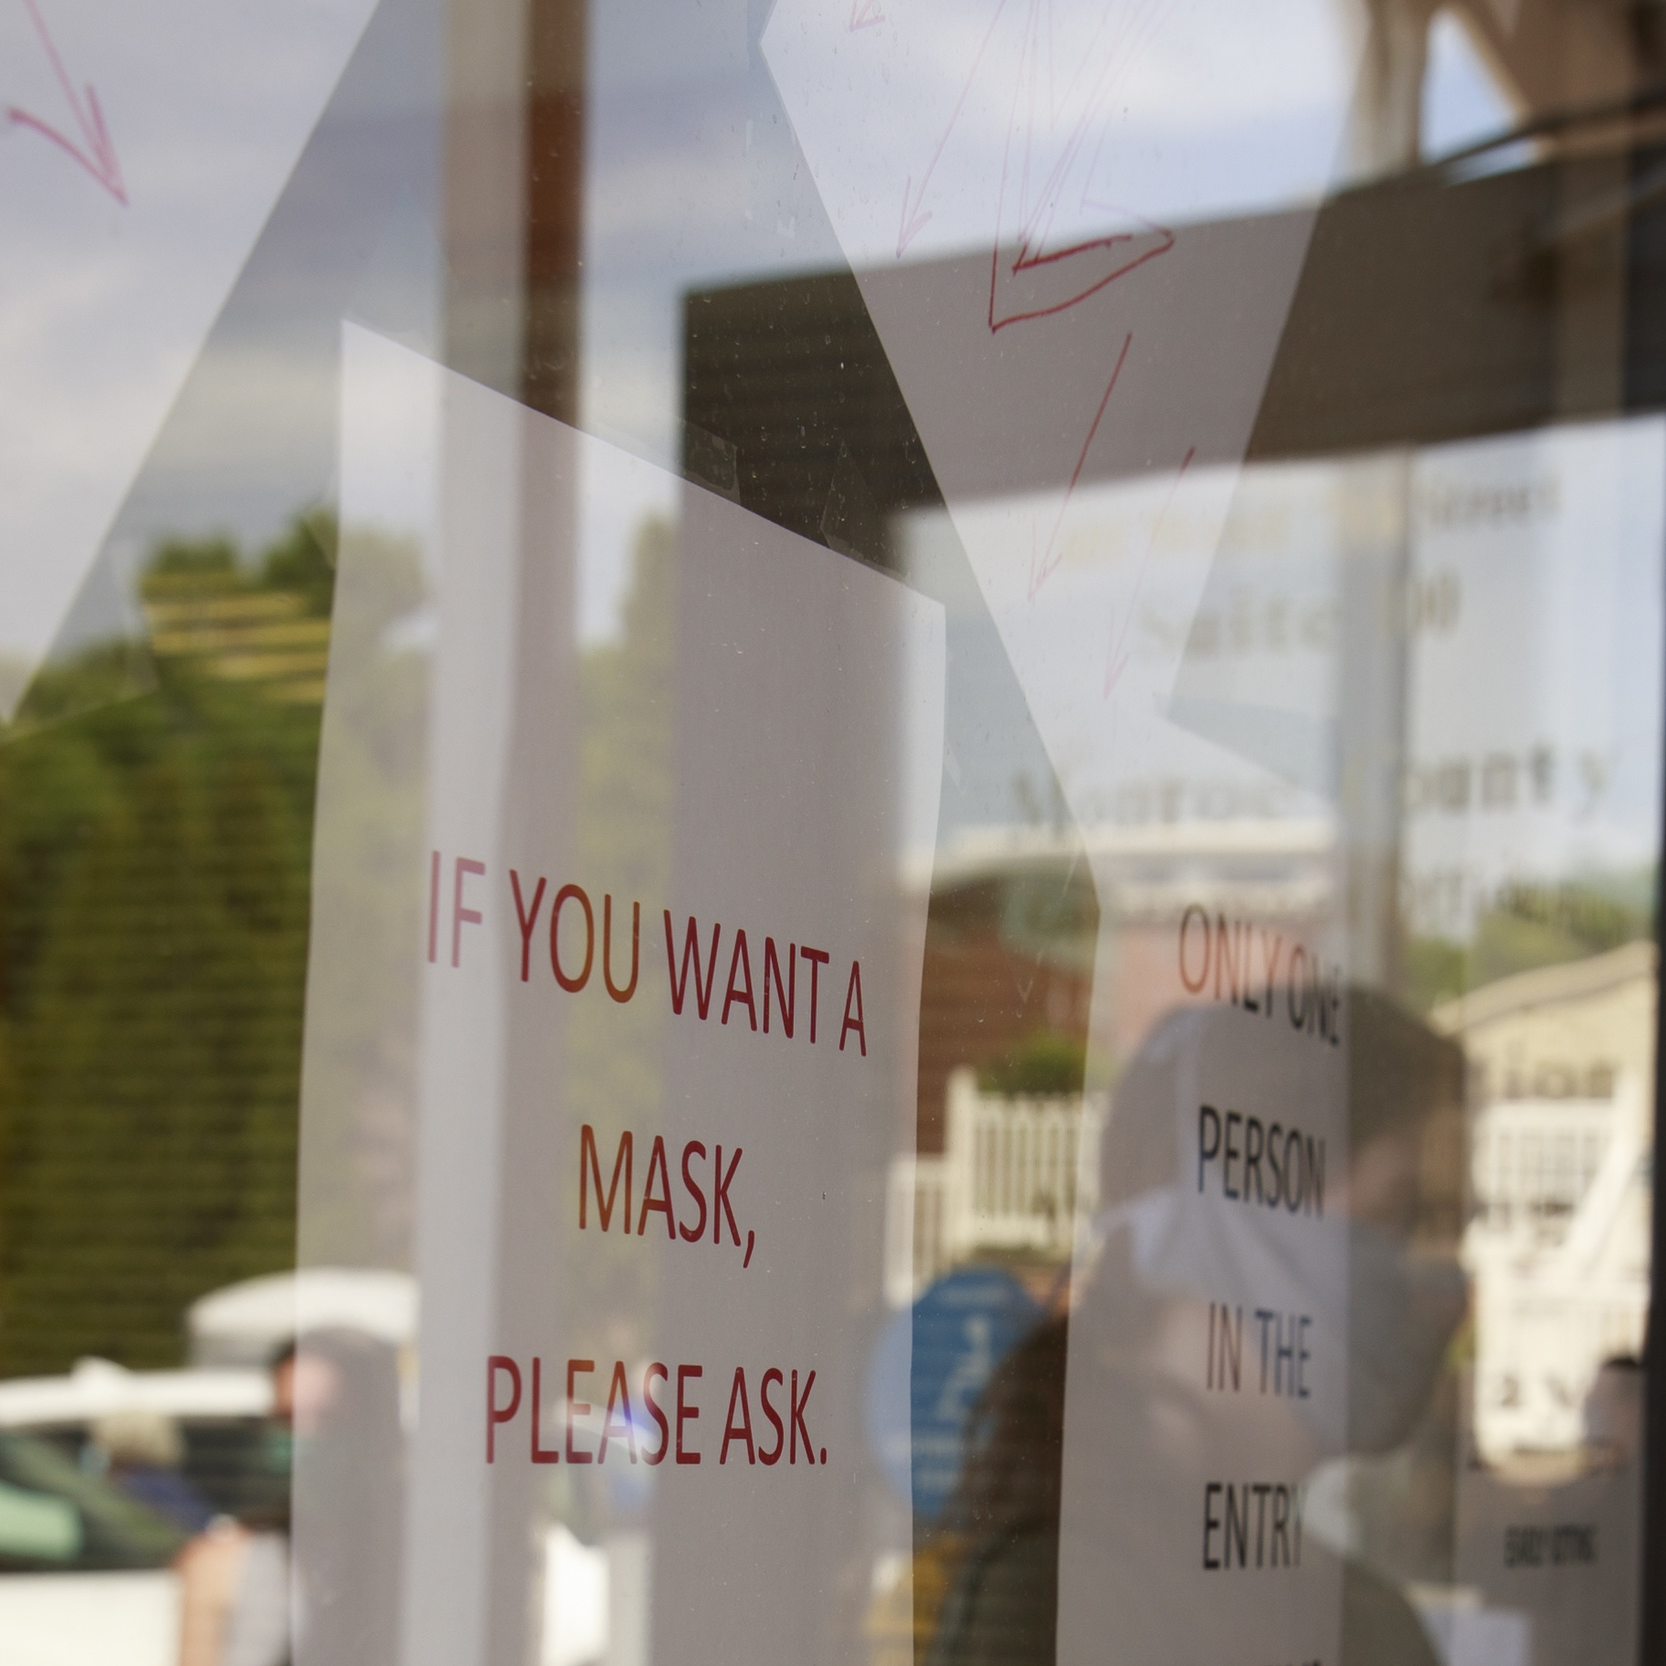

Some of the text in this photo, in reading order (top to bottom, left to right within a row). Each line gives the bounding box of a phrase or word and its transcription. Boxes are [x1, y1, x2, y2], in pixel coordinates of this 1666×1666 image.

[427, 850, 868, 1058] IF YOU WANT A
[1179, 903, 1340, 1047] ONLY ONE
[578, 1123, 756, 1270] MASK,
[1197, 1104, 1326, 1222] PERSON
[485, 1354, 704, 1466] PLEASE
[718, 1365, 829, 1466] ASK.
[1206, 1302, 1313, 1399] IN THE
